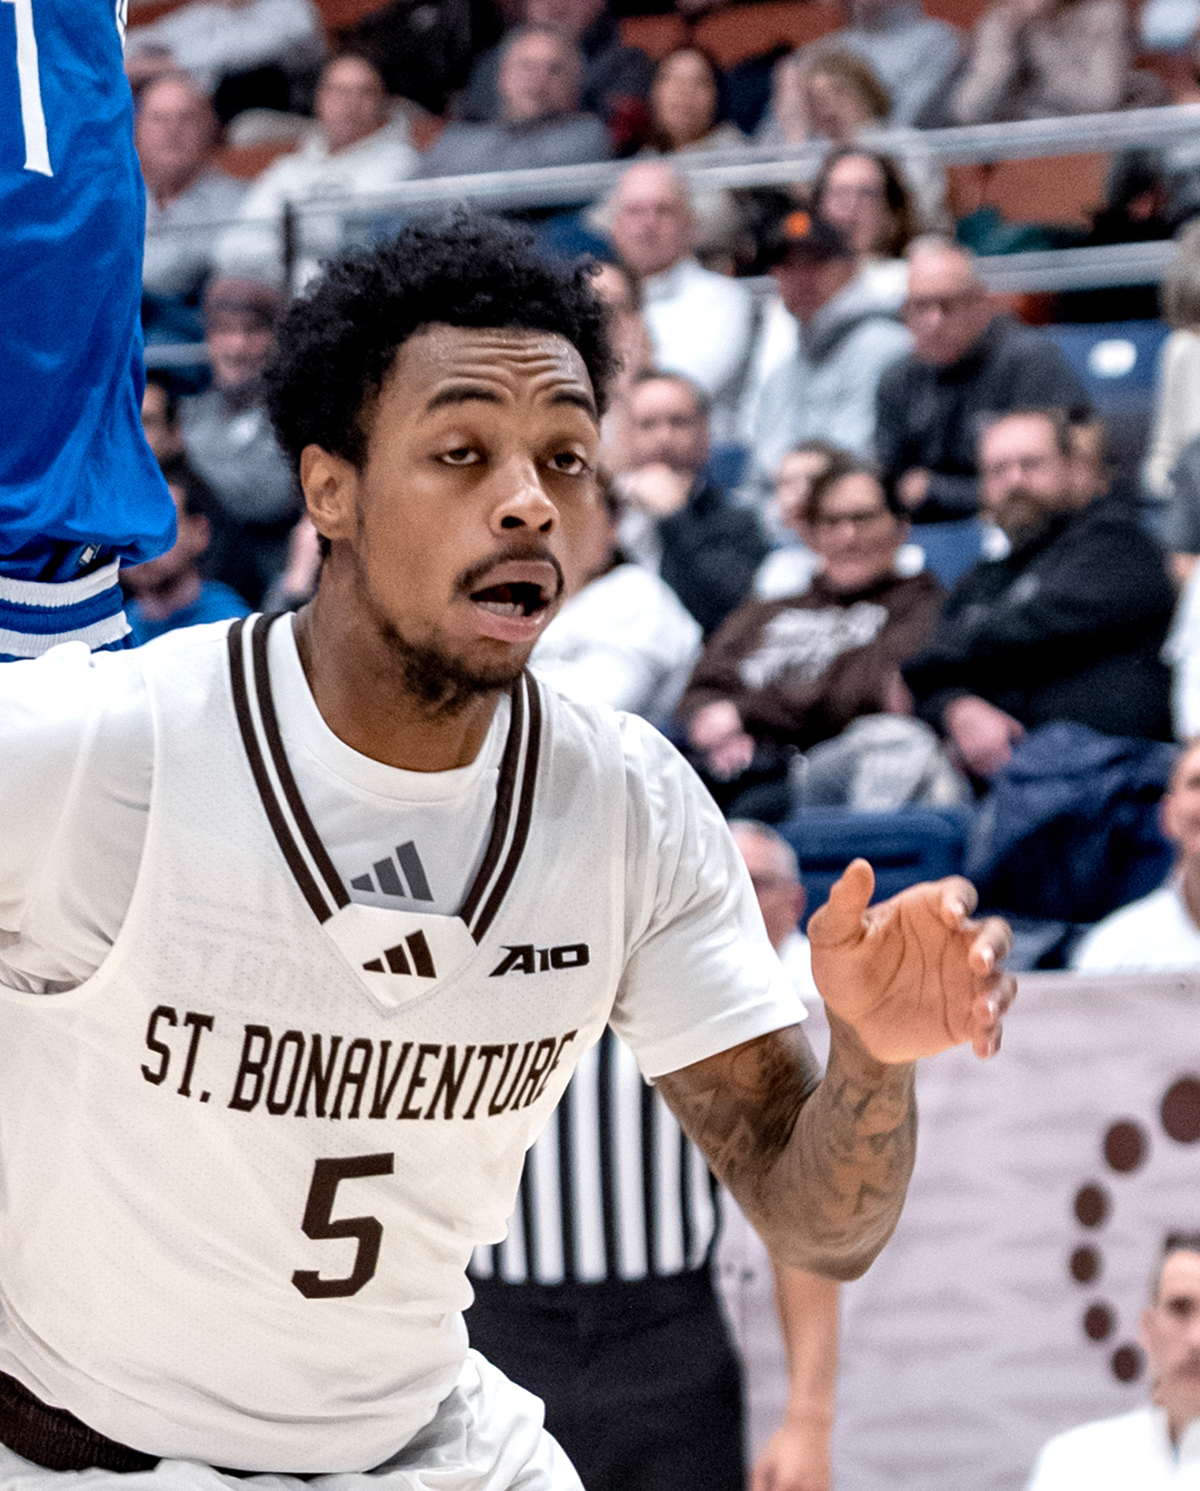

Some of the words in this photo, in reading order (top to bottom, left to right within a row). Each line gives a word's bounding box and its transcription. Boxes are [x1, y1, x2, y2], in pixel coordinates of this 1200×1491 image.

[141, 1005, 215, 1103] ST.
[227, 1024, 579, 1121] BONAVENTURE
[291, 1152, 395, 1299] 5
